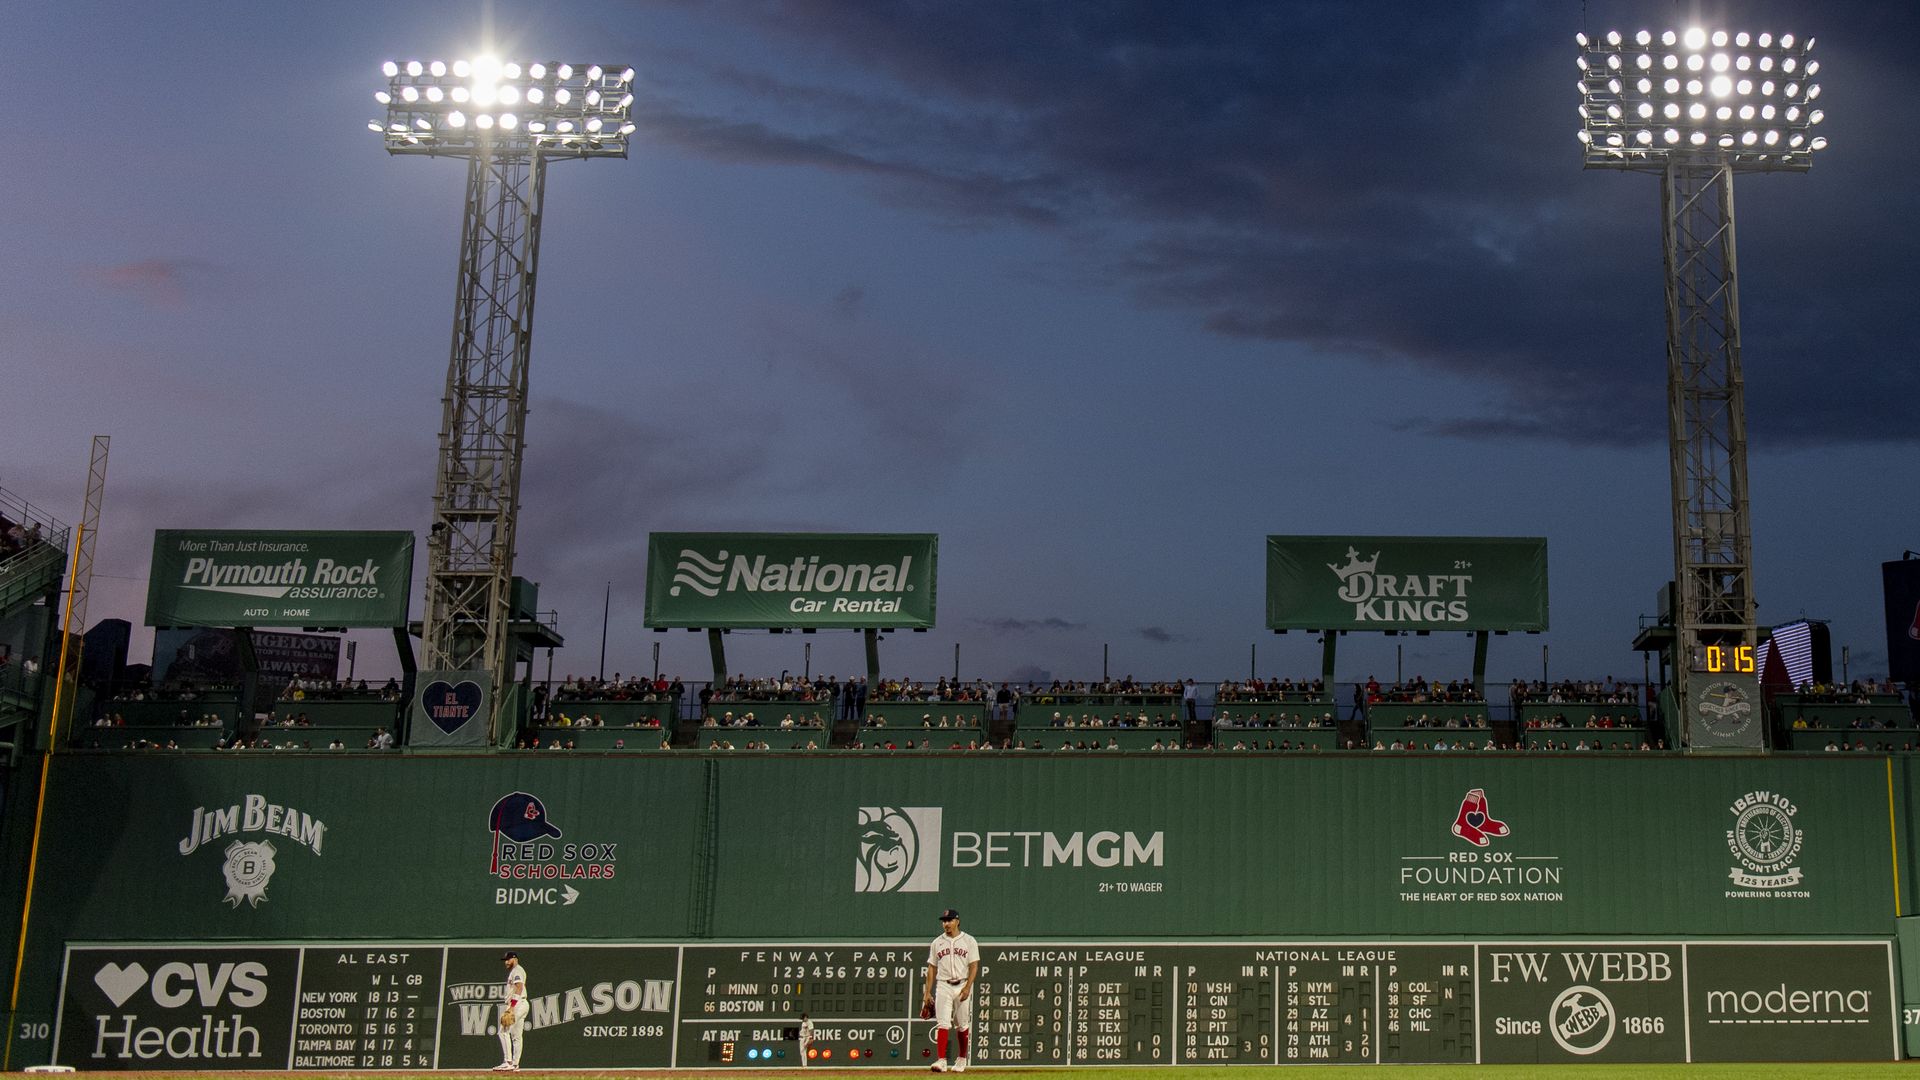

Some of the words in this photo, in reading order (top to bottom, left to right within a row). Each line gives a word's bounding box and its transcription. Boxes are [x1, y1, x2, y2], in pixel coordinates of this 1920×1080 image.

[179, 541, 206, 552] More
[209, 541, 234, 552] Than
[235, 541, 256, 552] Just
[258, 541, 309, 552] Insurance.
[1454, 560, 1473, 569] 21+
[183, 558, 307, 587] Plymouth
[312, 558, 380, 585] Rock
[726, 555, 913, 592] National
[289, 586, 378, 599] assurance
[1338, 572, 1473, 602] DRAFT
[789, 597, 826, 613] Car
[832, 597, 902, 613] Rental
[1354, 597, 1469, 622] KINGS
[243, 609, 269, 617] AUTO
[283, 609, 310, 617] HOME
[1707, 646, 1754, 672] 0:15
[1700, 682, 1721, 699] BOSTON
[445, 692, 458, 705] EL
[433, 705, 470, 718] TIANTE
[1701, 718, 1711, 730] THE
[1737, 718, 1751, 734] FUND
[1729, 791, 1770, 816] IBEW
[1772, 793, 1797, 817] 103
[179, 804, 241, 856] JIM
[242, 794, 325, 856] BEAM
[501, 844, 555, 861] RED
[563, 843, 617, 861] SOX
[952, 831, 1164, 868] BETMGM
[1727, 830, 1742, 860] NECA
[1742, 829, 1803, 873] CONTRACTORS
[1449, 852, 1478, 863] RED
[1484, 852, 1513, 863] SOX
[243, 861, 255, 875] B
[499, 864, 615, 879] SCHOLARS
[1401, 867, 1560, 885] FOUNDATION
[1740, 876, 1757, 886] 125
[1760, 875, 1794, 887] YEARS
[1099, 883, 1114, 892] 21+
[1116, 883, 1128, 892] TO
[1130, 883, 1162, 892] WAGER
[495, 888, 558, 905] BIDMC
[1400, 893, 1420, 901] THE
[1423, 893, 1457, 901] HEART
[1460, 893, 1474, 901] OF
[1477, 893, 1498, 901] RED
[1500, 893, 1521, 901] SOX
[1524, 893, 1563, 901] NATION
[337, 954, 358, 964] AL
[366, 954, 410, 964] EAST
[741, 952, 834, 962] FENWAY
[853, 952, 913, 962] PARK
[937, 947, 951, 960] RED
[953, 947, 969, 959] SOX
[997, 952, 1077, 961] AMERICAN
[1086, 952, 1145, 961] LEAGUE
[1256, 951, 1330, 961] NATIONAL
[1338, 951, 1396, 961] LEAGUE
[707, 967, 716, 978] P
[981, 966, 990, 977] P
[1036, 966, 1048, 977] IN
[1054, 966, 1062, 977] R
[1490, 952, 1551, 983] F.W.
[1561, 952, 1672, 983] WEBB
[151, 961, 268, 1008] CVS
[372, 974, 381, 985] W
[391, 974, 399, 985] L
[406, 974, 423, 985] GB
[450, 986, 486, 1000] WHO
[488, 985, 507, 999] BU
[705, 984, 716, 995] 41
[728, 983, 758, 995] MINN
[1004, 984, 1020, 993] KC
[1098, 983, 1122, 993] DET
[1206, 982, 1232, 993] WSH
[1307, 982, 1332, 993] NYM
[1408, 982, 1431, 993] COL
[302, 992, 326, 1003] NEW
[329, 992, 358, 1003] YORK
[368, 991, 380, 1003] 18
[387, 991, 399, 1003] 13
[1000, 996, 1023, 1007] BAL
[1098, 996, 1121, 1006] LAA
[1209, 995, 1228, 1006] CIN
[1308, 995, 1331, 1006] STL
[1412, 995, 1427, 1005] SF
[1707, 983, 1869, 1013] moderna
[704, 1001, 716, 1012] 66
[719, 1001, 764, 1012] BOSTON
[300, 1008, 346, 1019] BOSTON
[367, 1007, 379, 1019] 17
[385, 1007, 398, 1019] 16
[407, 1007, 415, 1019] 2
[1004, 1010, 1019, 1020] TB
[1098, 1009, 1121, 1020] SEA
[1211, 1009, 1226, 1019] SD
[1312, 1008, 1328, 1019] AZ
[1408, 1008, 1432, 1019] CHC
[1495, 1017, 1542, 1035] Since
[1622, 1017, 1665, 1034] 1866
[1565, 1007, 1601, 1034] WEBB
[20, 1023, 49, 1040] 310
[299, 1024, 353, 1035] TORONTO
[365, 1023, 377, 1035] 15
[384, 1023, 396, 1035] 16
[406, 1023, 414, 1035] 3
[583, 1025, 628, 1037] SINCE
[632, 1025, 664, 1037] 1898
[999, 1022, 1022, 1033] NYY
[1098, 1022, 1121, 1033] TEX
[1209, 1022, 1228, 1032] PIT
[1310, 1021, 1329, 1032] PHI
[1410, 1021, 1430, 1032] MIL
[91, 1014, 262, 1059] Health
[702, 1030, 717, 1041] AT
[720, 1030, 741, 1041] BAT
[752, 1029, 784, 1041] BALL
[801, 1029, 841, 1041] RIKE
[848, 1029, 875, 1041] OUT
[1207, 1035, 1229, 1046] LAD
[1309, 1035, 1331, 1045] ATH
[298, 1040, 332, 1051] TAMPA
[335, 1040, 357, 1051] BAY
[364, 1039, 376, 1051] 14
[382, 1039, 395, 1051] 17
[404, 1039, 412, 1051] 4
[999, 1036, 1022, 1046] CLE
[1097, 1036, 1122, 1046] HOU
[722, 1043, 734, 1062] 9
[998, 1049, 1022, 1060] TOR
[1097, 1049, 1121, 1059] CWS
[1207, 1048, 1229, 1059] ATL
[1310, 1047, 1329, 1058] MIA
[295, 1056, 355, 1067] BALTIMORE
[362, 1055, 374, 1067] 12
[381, 1055, 393, 1067] 18
[402, 1055, 411, 1067] 5
